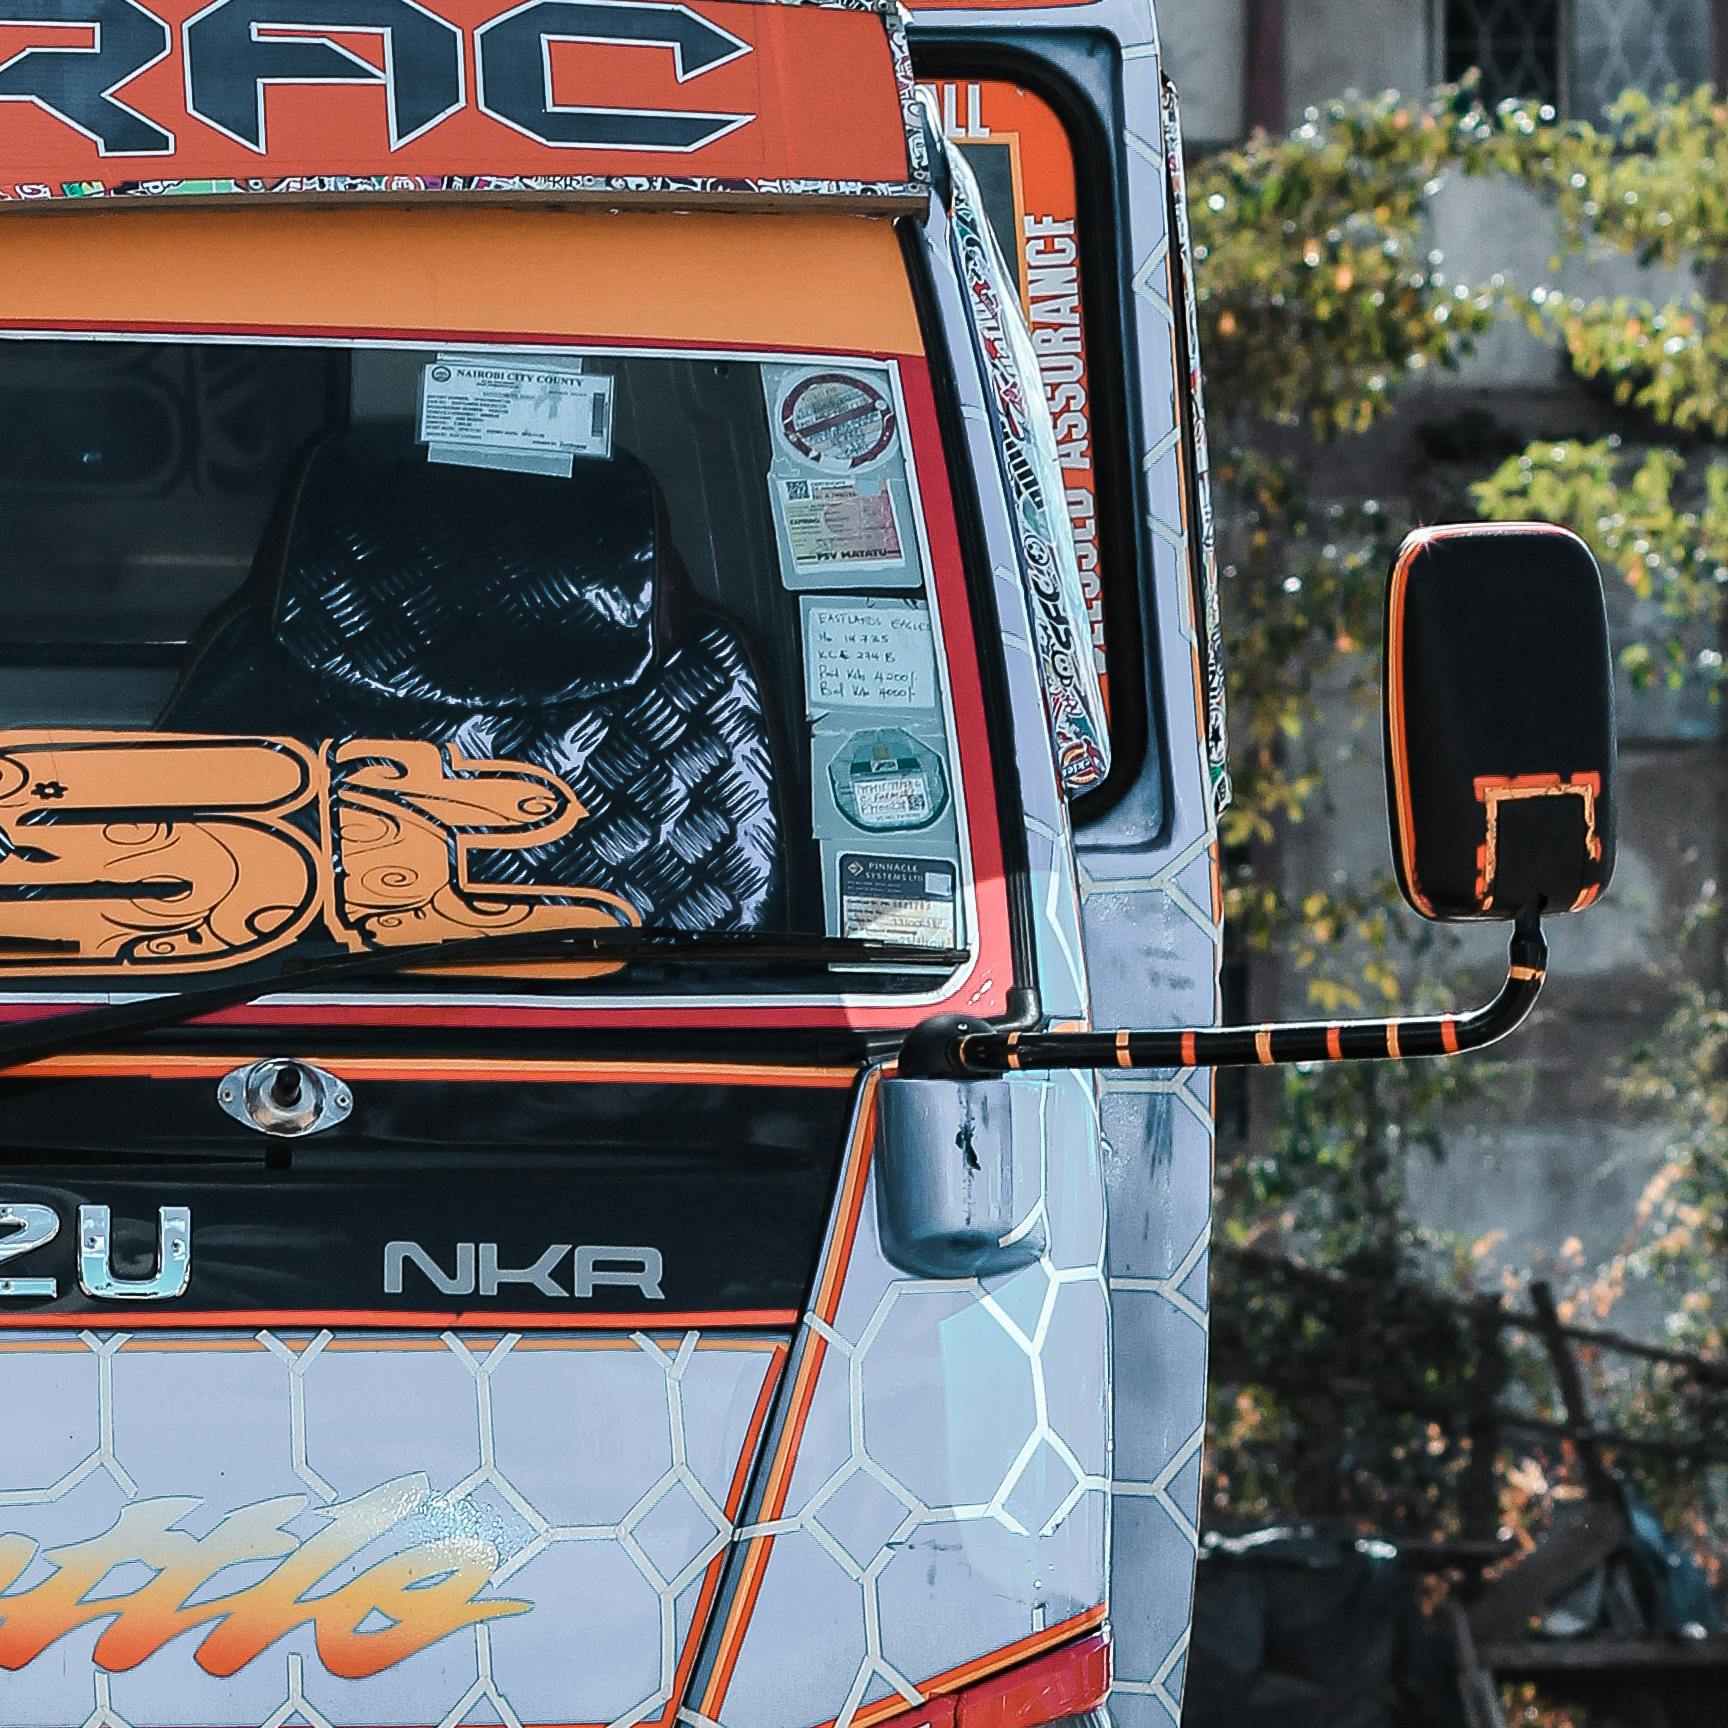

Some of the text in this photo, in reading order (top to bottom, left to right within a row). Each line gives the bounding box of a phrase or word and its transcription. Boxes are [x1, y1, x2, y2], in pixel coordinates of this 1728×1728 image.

[456, 368, 584, 387] NAIROBI CITY COUNTY
[868, 862, 919, 872] PINNACLE
[866, 871, 906, 882] SYSTEMS
[381, 1240, 666, 1300] NKR
